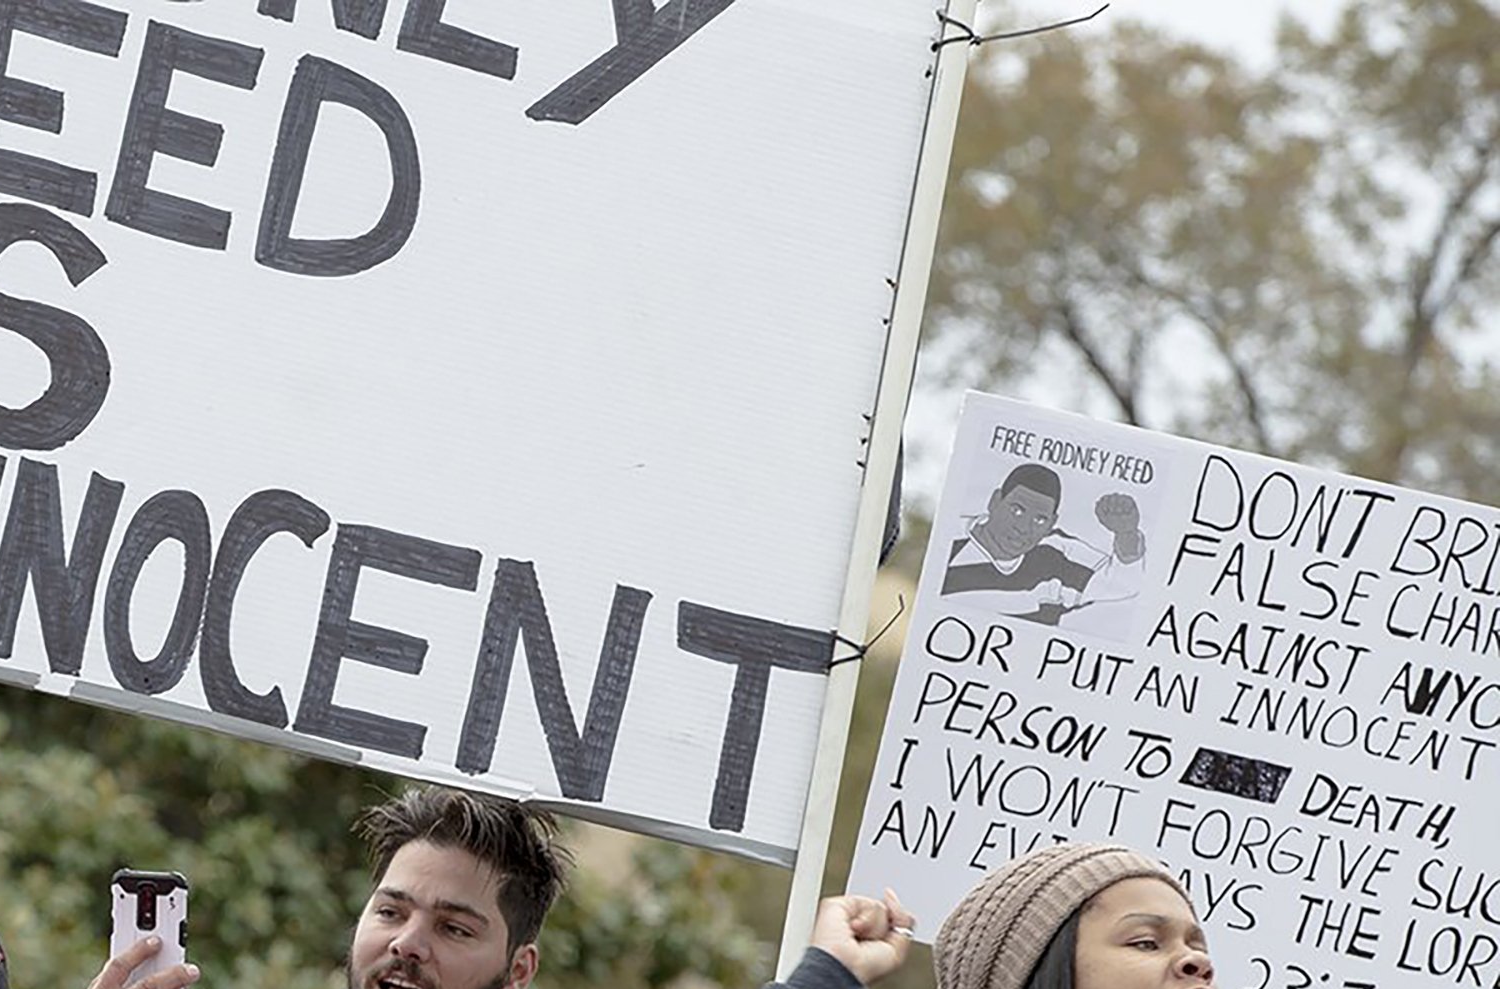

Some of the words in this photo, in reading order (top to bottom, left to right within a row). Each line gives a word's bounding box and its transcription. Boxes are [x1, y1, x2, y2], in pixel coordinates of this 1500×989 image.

[990, 425, 1036, 459] FREE
[1038, 437, 1111, 475] RODNEY
[1110, 454, 1155, 485] REED
[1167, 533, 1380, 627] FALSE
[1390, 506, 1500, 596] BRI
[925, 616, 1010, 673] OR
[1036, 638, 1134, 696] PUT
[1133, 665, 1200, 714] AN
[1219, 681, 1497, 781] INNOCENT
[1147, 604, 1372, 695] AGAINST
[889, 738, 919, 790] I
[945, 747, 1141, 837] WON'T
[1156, 798, 1400, 897] FORGIVE
[913, 671, 1108, 762] PERSON
[1124, 729, 1173, 779] TO
[1299, 773, 1456, 850] DEATH,
[872, 799, 956, 860] AN
[1295, 894, 1382, 961] THE
